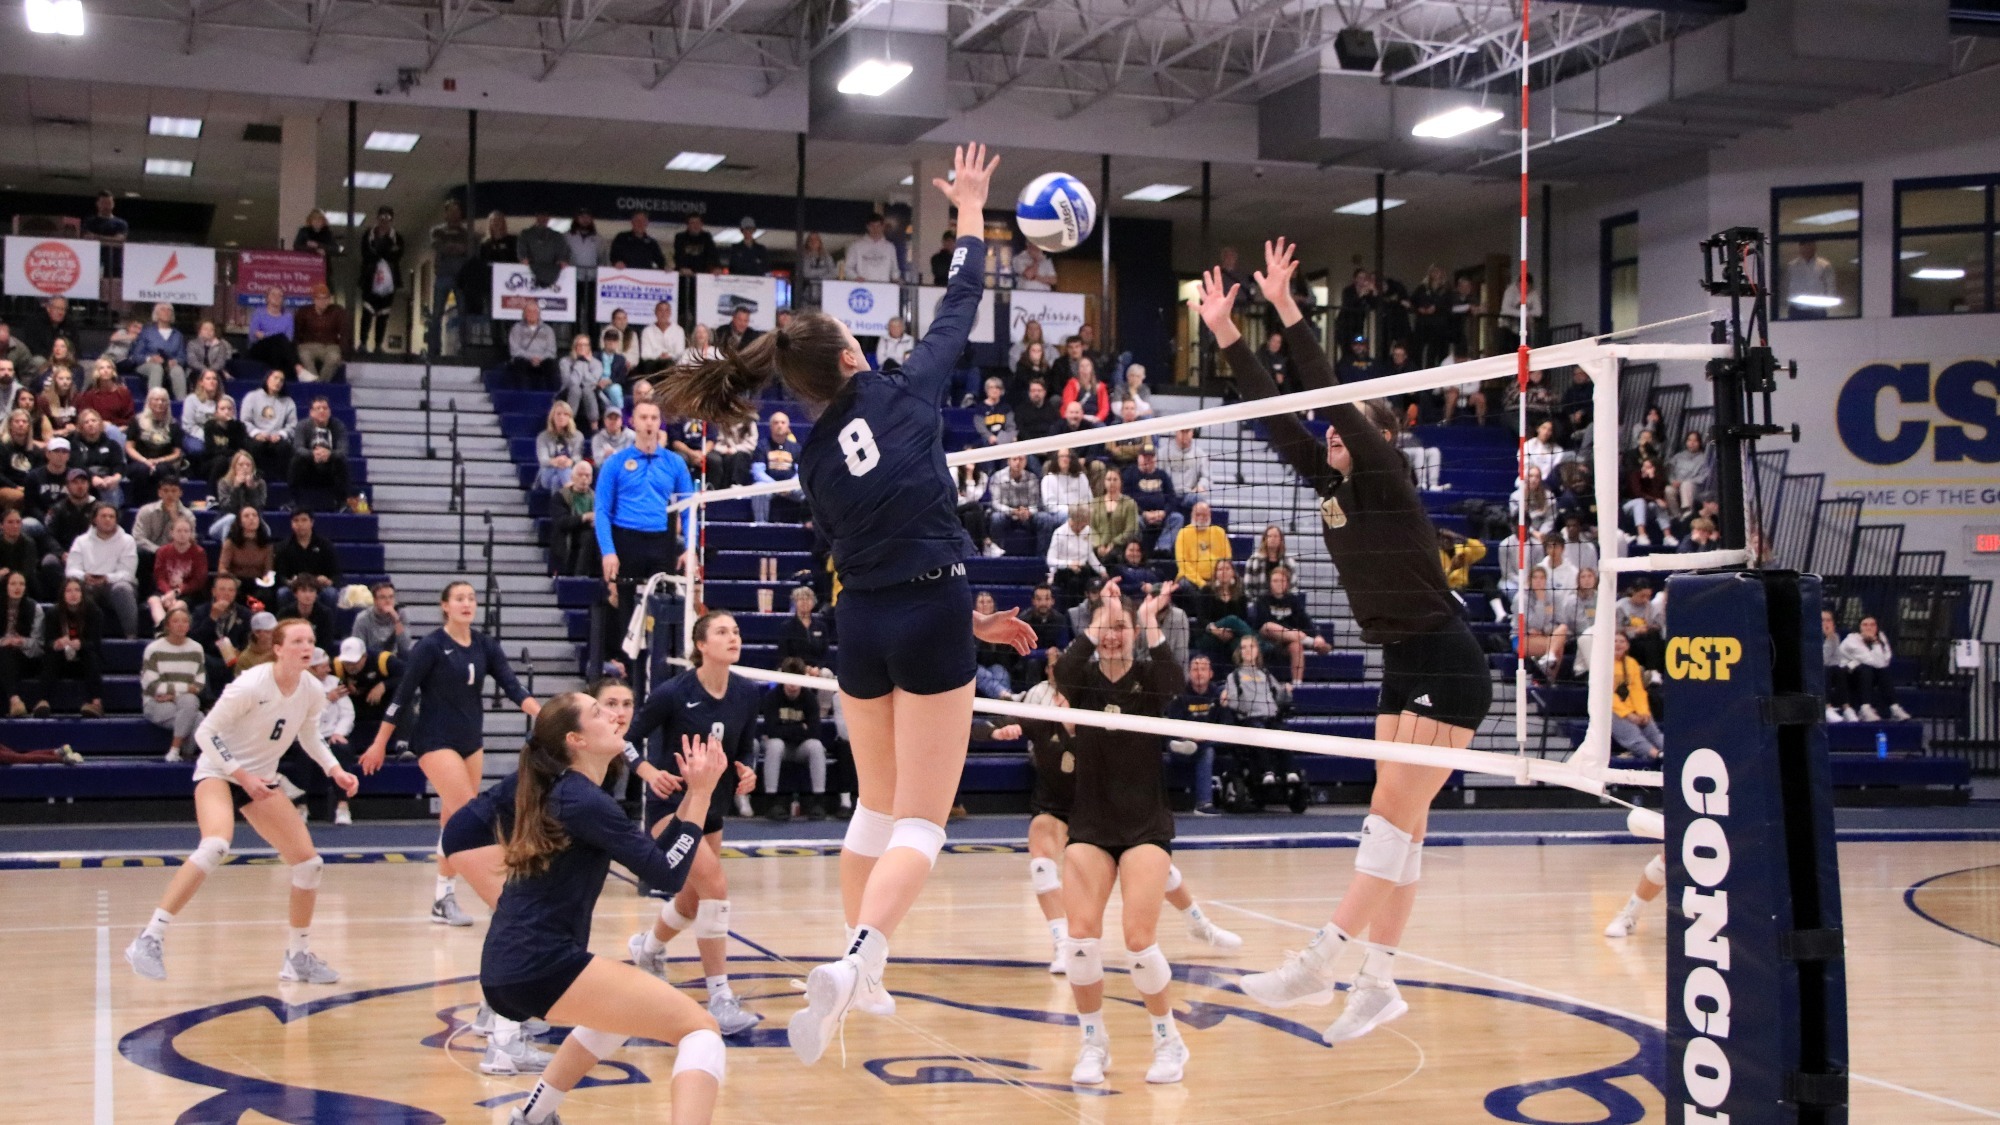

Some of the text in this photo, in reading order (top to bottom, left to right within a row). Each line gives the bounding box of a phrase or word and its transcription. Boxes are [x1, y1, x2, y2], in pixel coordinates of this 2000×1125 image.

[616, 197, 707, 214] CONCESSIONS
[30, 258, 76, 268] LAKES
[601, 284, 673, 294] AMERICAN FAMILY
[838, 417, 881, 477] 8
[1836, 489, 1897, 505] HOME
[1902, 489, 1931, 505] OF
[1936, 488, 1977, 505] THE
[1665, 636, 1742, 681] CSP
[467, 662, 476, 686] 1
[269, 718, 287, 741] 6
